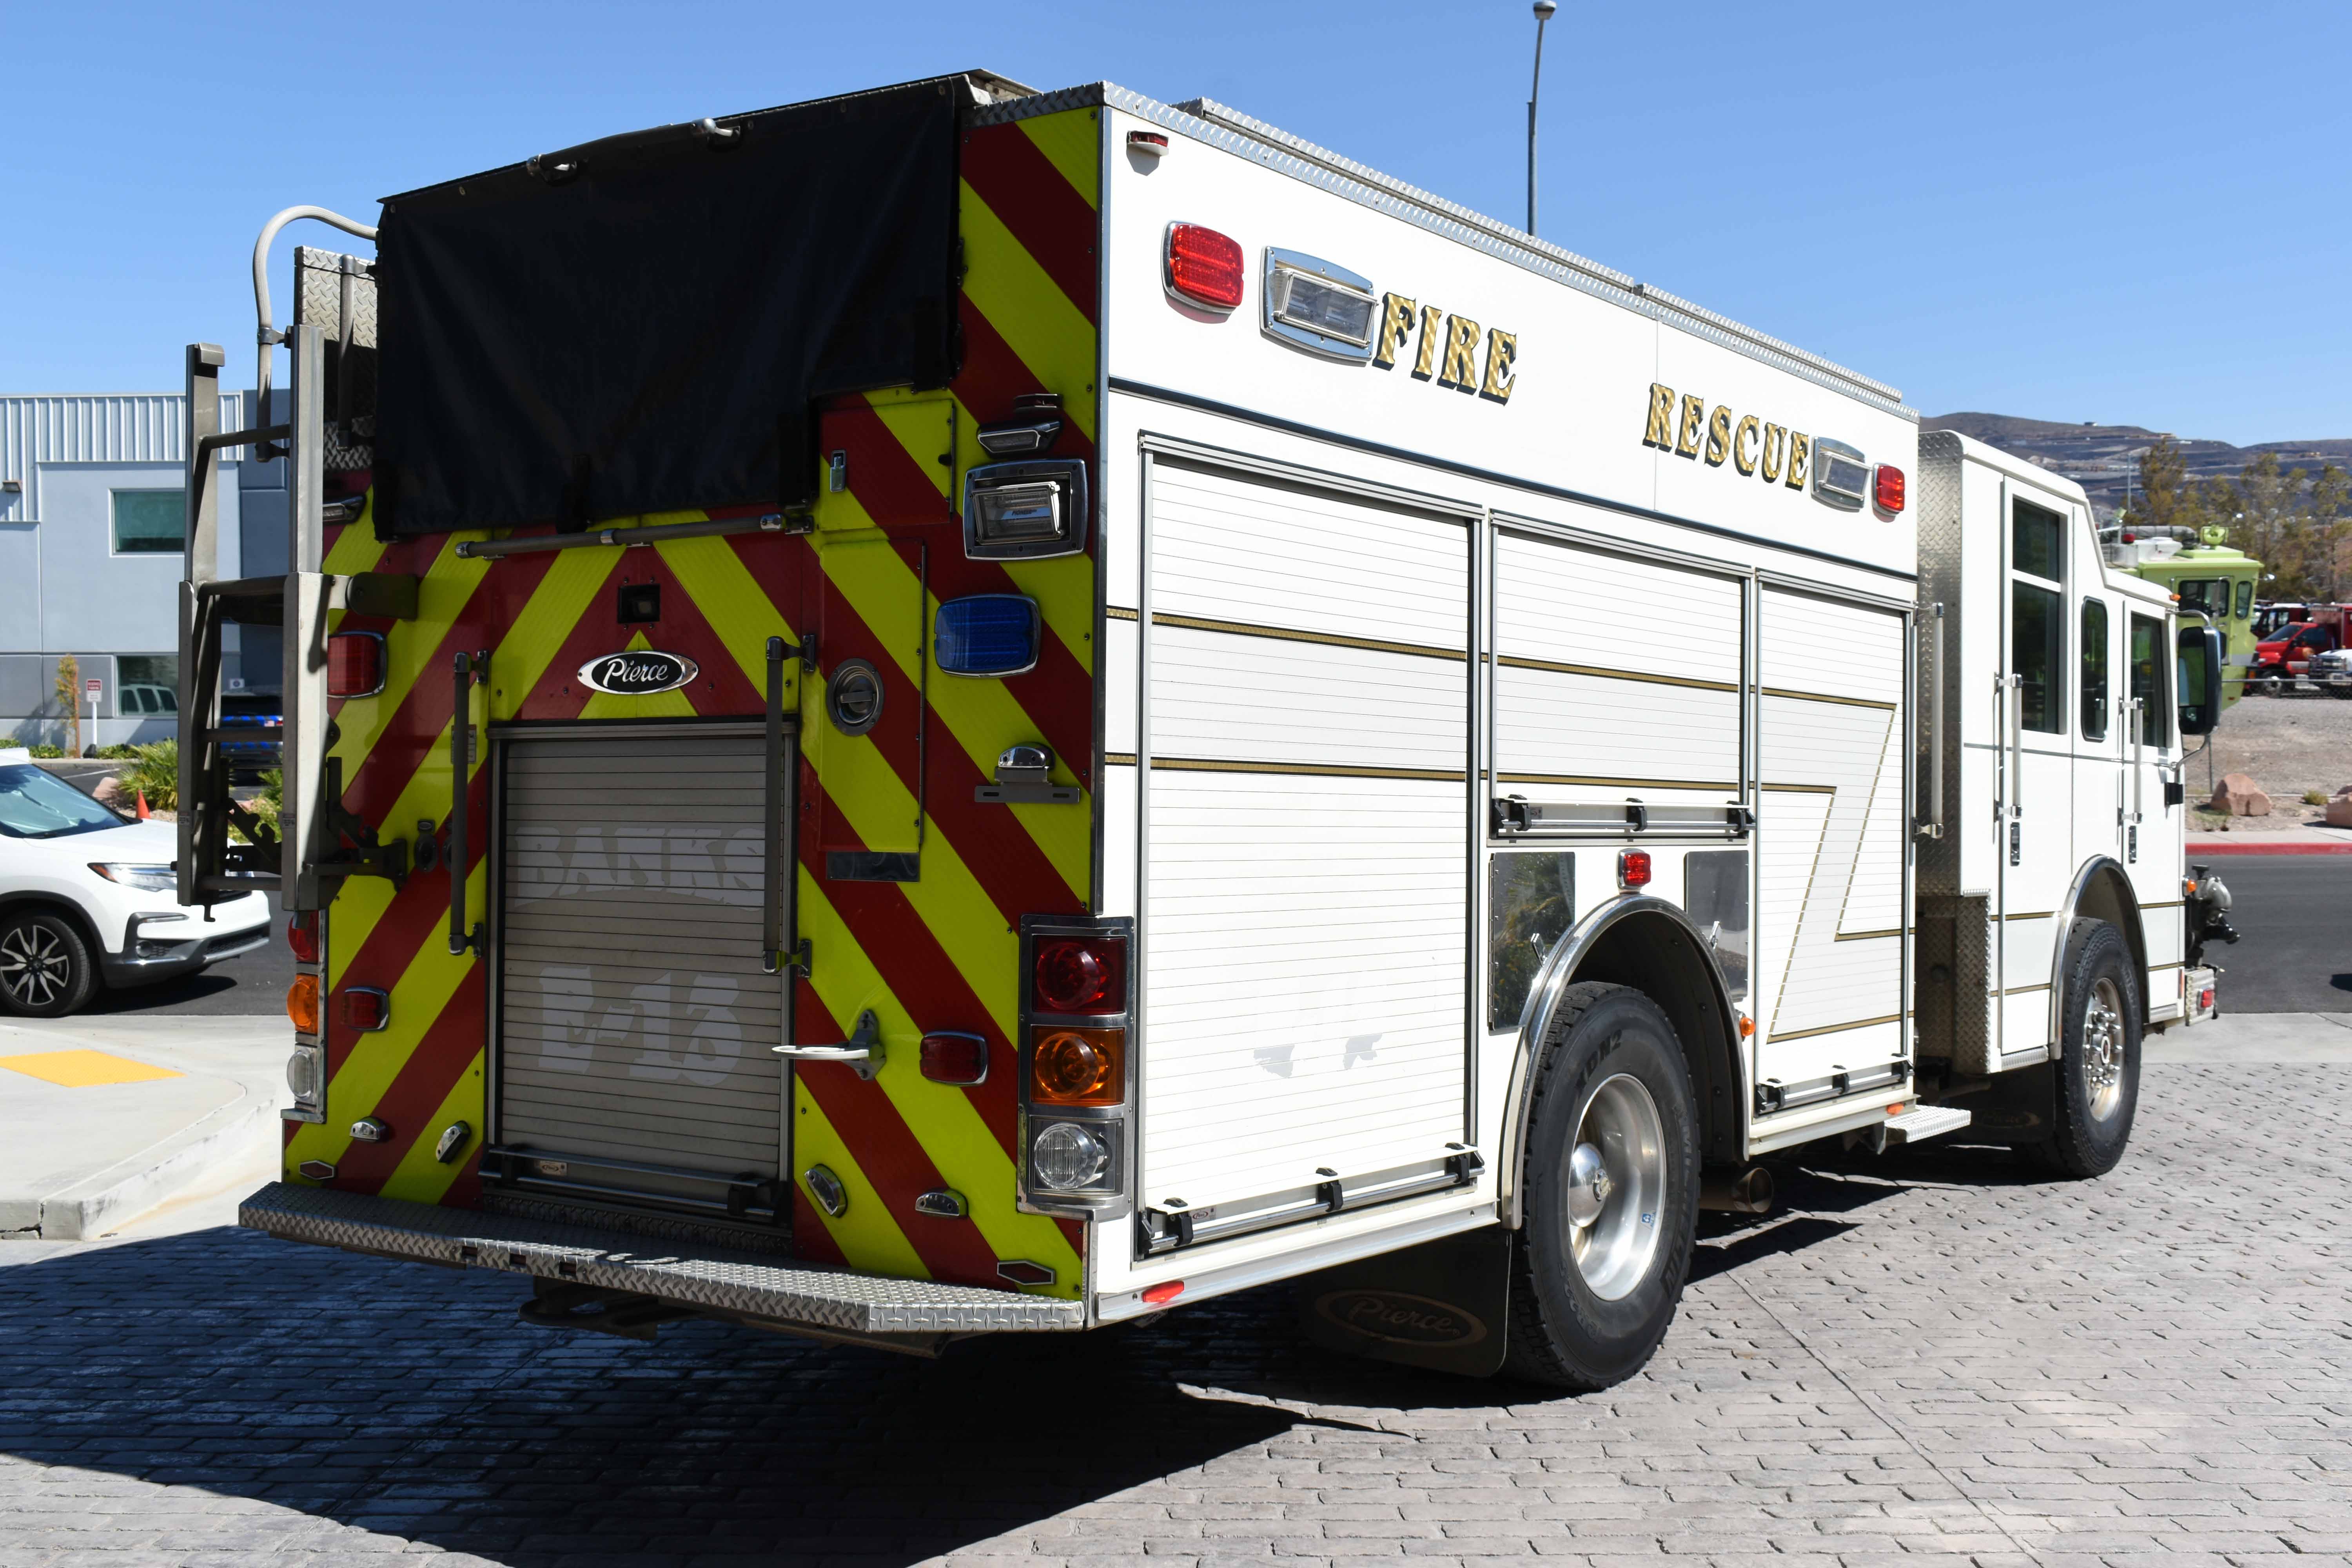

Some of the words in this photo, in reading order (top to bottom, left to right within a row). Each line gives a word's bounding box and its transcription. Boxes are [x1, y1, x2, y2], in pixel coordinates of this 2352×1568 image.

[1372, 292, 1517, 406] FIRE
[1642, 383, 1809, 491] RESCUE
[603, 658, 669, 688] Pierce
[514, 826, 765, 911] BANKS
[1347, 1296, 1452, 1332] Pierce
